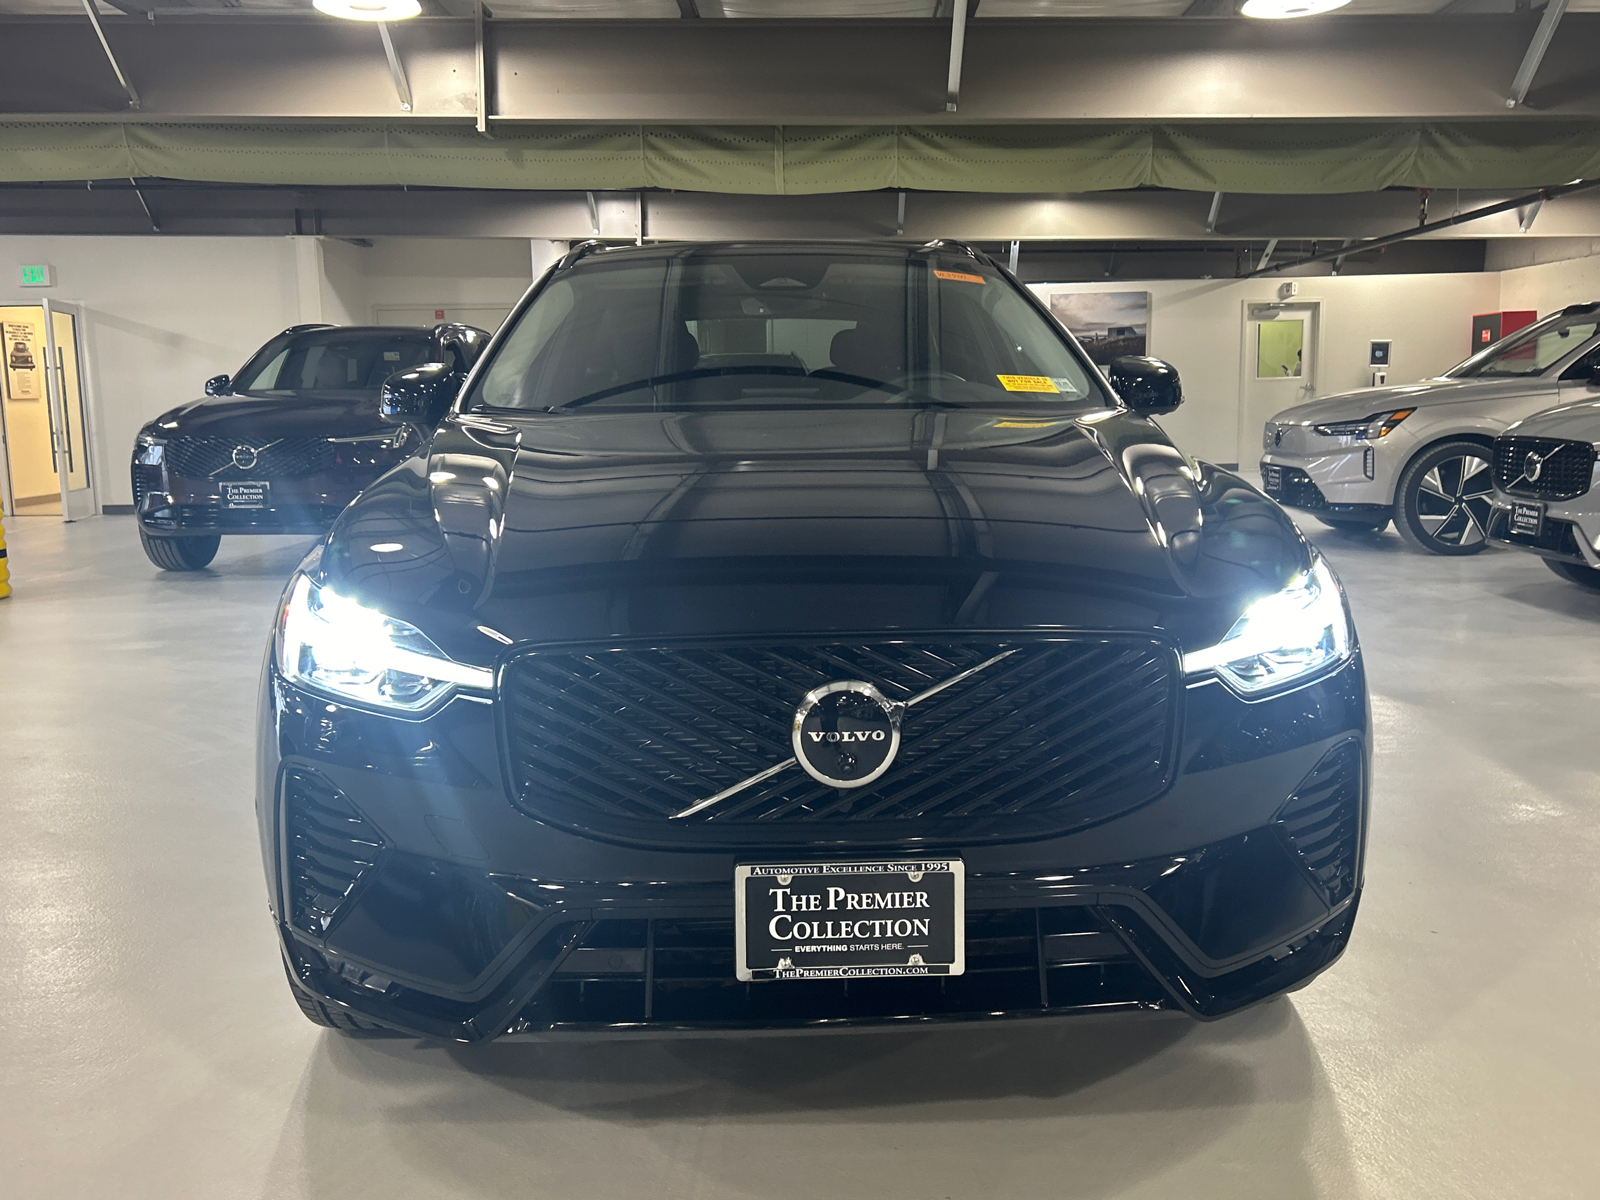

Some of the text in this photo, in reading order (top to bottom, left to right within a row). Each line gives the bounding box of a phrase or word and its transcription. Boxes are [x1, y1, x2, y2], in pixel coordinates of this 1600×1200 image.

[23, 266, 44, 283] EXIT
[808, 729, 886, 743] VOLVO
[753, 862, 948, 875] AUTOMOTIVE EXCELLENCE SINCE 1995
[768, 886, 930, 912] THE PREMIER
[768, 914, 931, 941] COLLECTION
[794, 942, 905, 953] EVERYTHING STARTS HERE.
